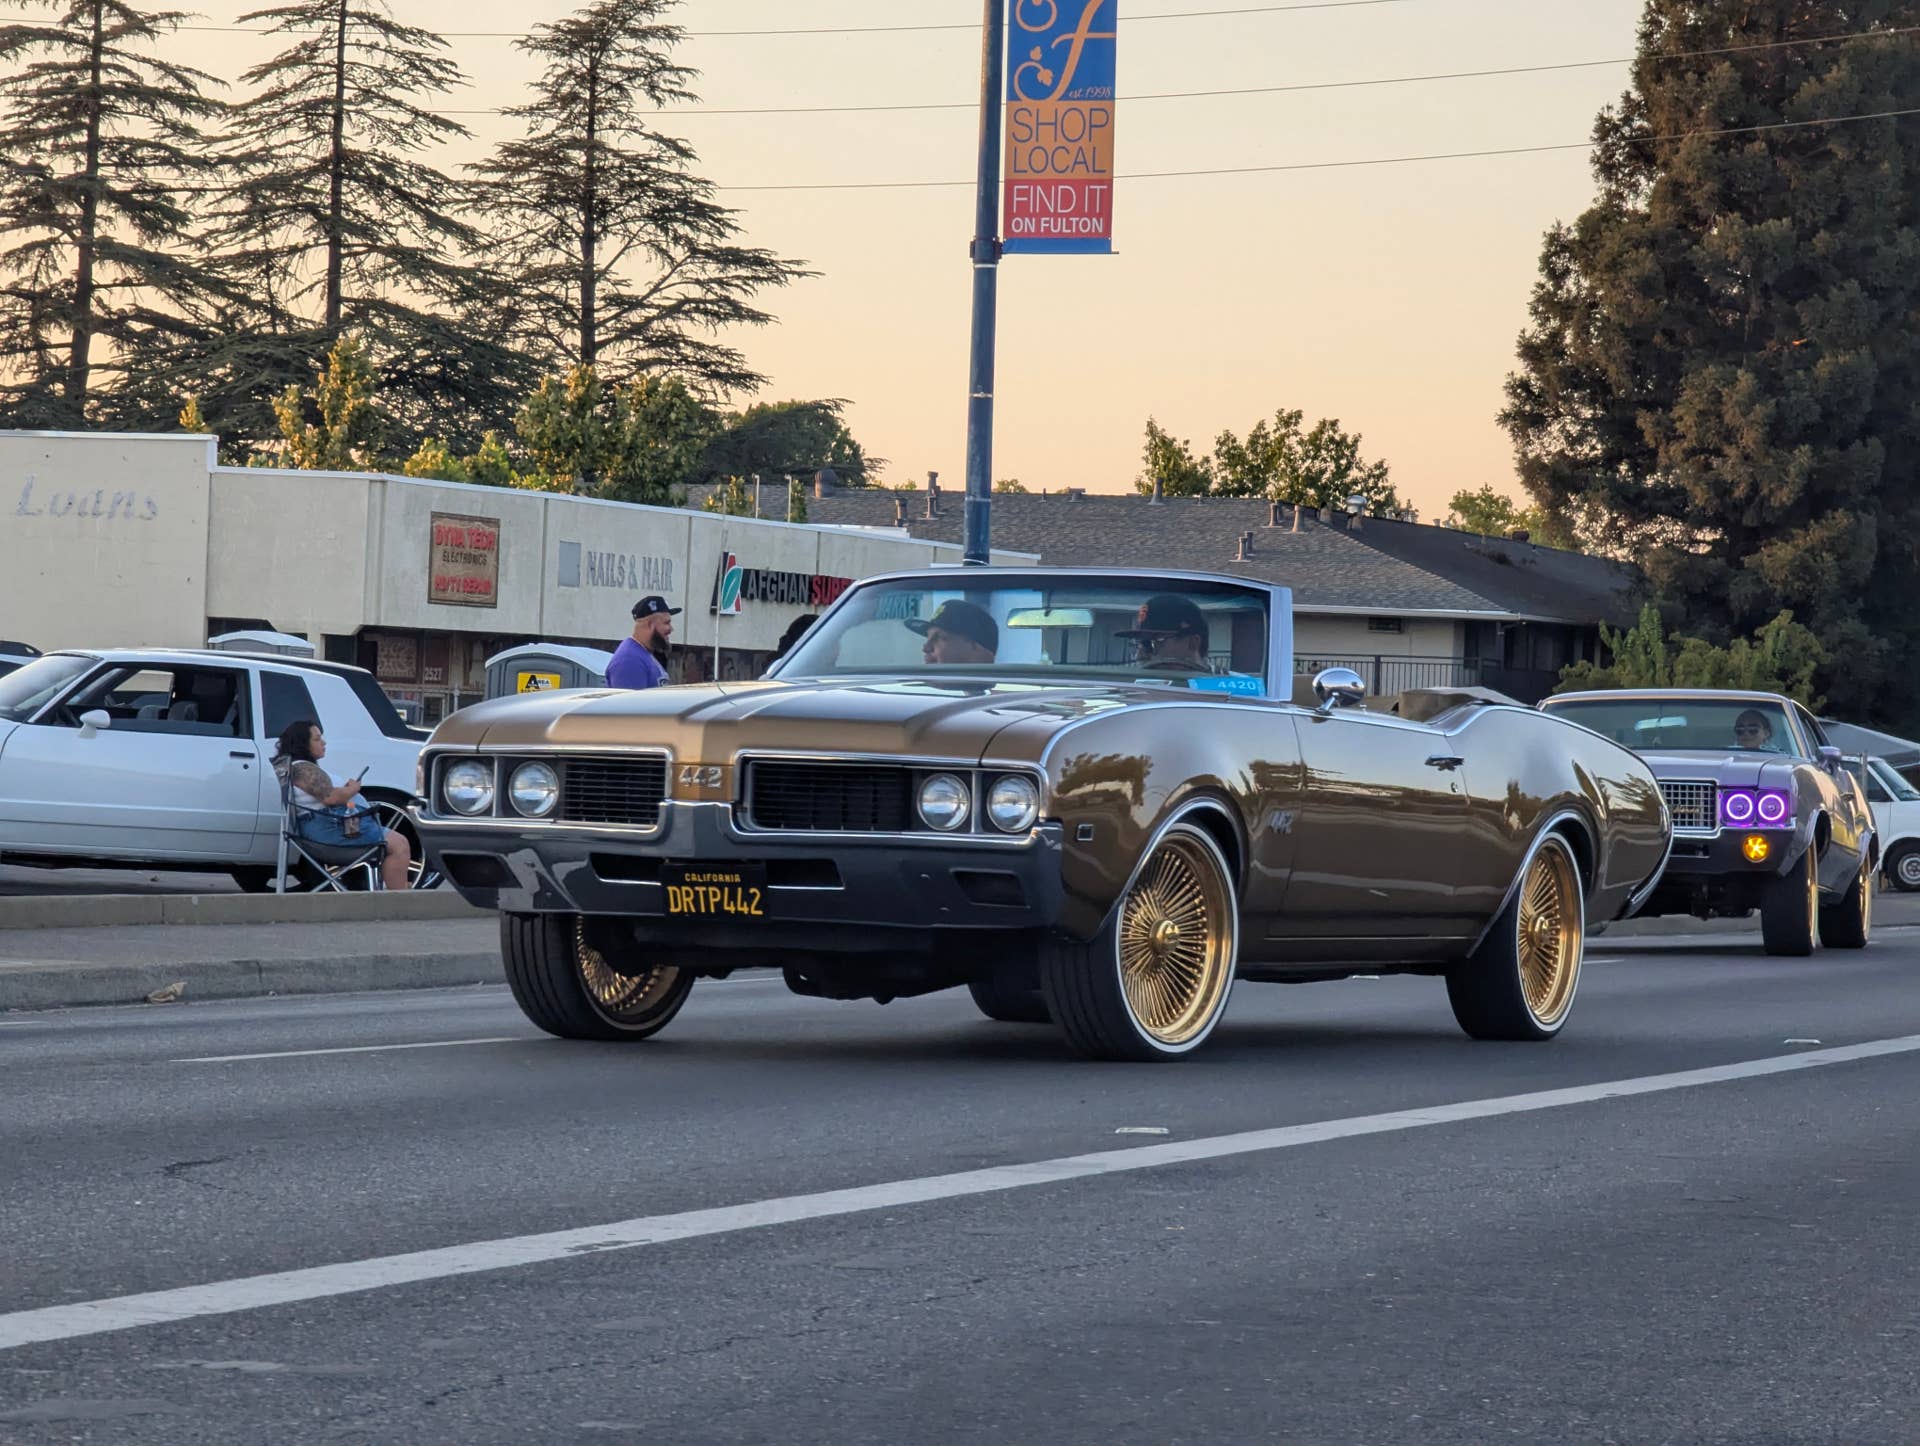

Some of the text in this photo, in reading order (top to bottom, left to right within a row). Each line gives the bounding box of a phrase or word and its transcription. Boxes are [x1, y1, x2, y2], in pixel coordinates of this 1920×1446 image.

[1086, 86, 1112, 98] 1998
[1012, 107, 1109, 143] SHOP
[1013, 146, 1107, 174] LOCAL
[1013, 185, 1108, 214] FIND IT
[1011, 217, 1104, 234] ON FULTON
[442, 551, 488, 566] ELECTRONICS
[586, 551, 674, 592] NAILS & HAIR
[747, 571, 810, 605] AFGHAN
[1218, 680, 1257, 691] 4420
[678, 765, 722, 788] 442
[684, 872, 742, 883] CALIFORNIA
[667, 886, 764, 915] DRTP442
